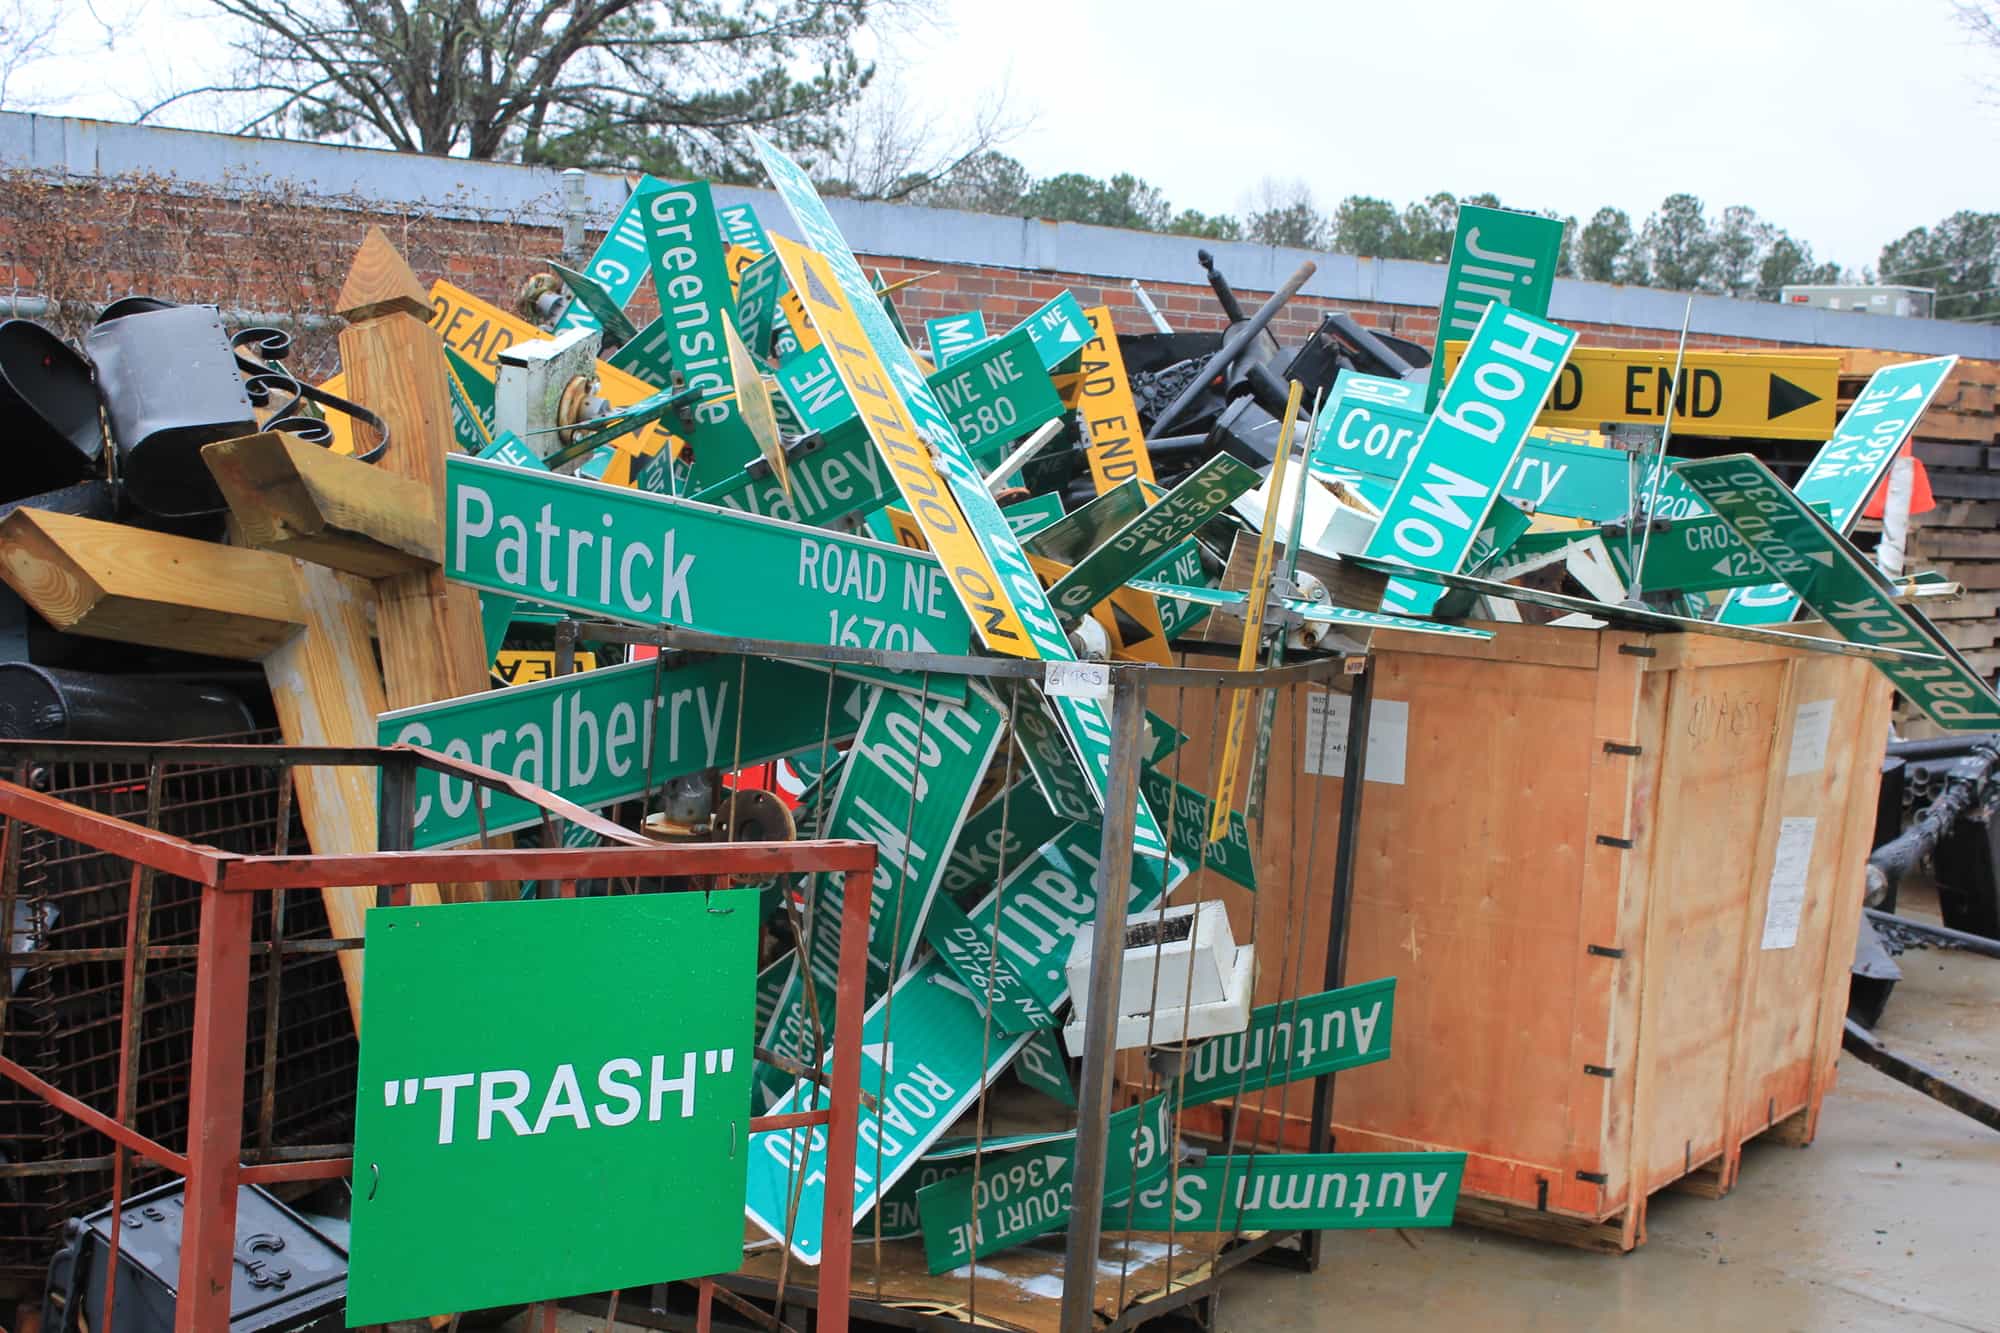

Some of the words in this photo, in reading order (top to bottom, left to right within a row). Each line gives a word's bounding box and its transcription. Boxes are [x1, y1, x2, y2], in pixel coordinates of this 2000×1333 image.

[651, 191, 734, 425] Greenside
[1041, 304, 1068, 331] NE
[790, 357, 846, 416] NE
[984, 349, 1023, 391] NE
[1438, 313, 1570, 444] Hog
[1625, 365, 1722, 418] END
[827, 330, 958, 534] OUTLET
[1090, 415, 1138, 482] END
[1811, 432, 1863, 481] WAY
[1854, 385, 1899, 418] NE
[1843, 418, 1905, 477] 3660
[1115, 492, 1196, 553] DRIVE
[1199, 459, 1239, 490] NE
[1155, 487, 1229, 540] 2330
[1694, 475, 1745, 505] NE
[1729, 473, 1800, 523] 1930
[455, 484, 697, 624] Patrick
[799, 538, 887, 603] ROAD
[903, 561, 947, 620] NE
[1175, 549, 1201, 585] NE
[1734, 516, 1812, 574] ROAD
[955, 565, 1020, 641] NO
[399, 681, 729, 830] Coralberry
[857, 691, 982, 802] Hog
[953, 927, 1020, 993] DRIVE
[1015, 998, 1053, 1028] NE
[954, 952, 1006, 1003] 1760
[1193, 1002, 1383, 1083] Autumn
[384, 1048, 734, 1144] "TRASH"
[858, 1064, 956, 1156] ROAD
[971, 1160, 1044, 1210] 3600
[1000, 1183, 1074, 1234] COURT
[1236, 1171, 1448, 1219] Autumn
[949, 1225, 985, 1257] NE
